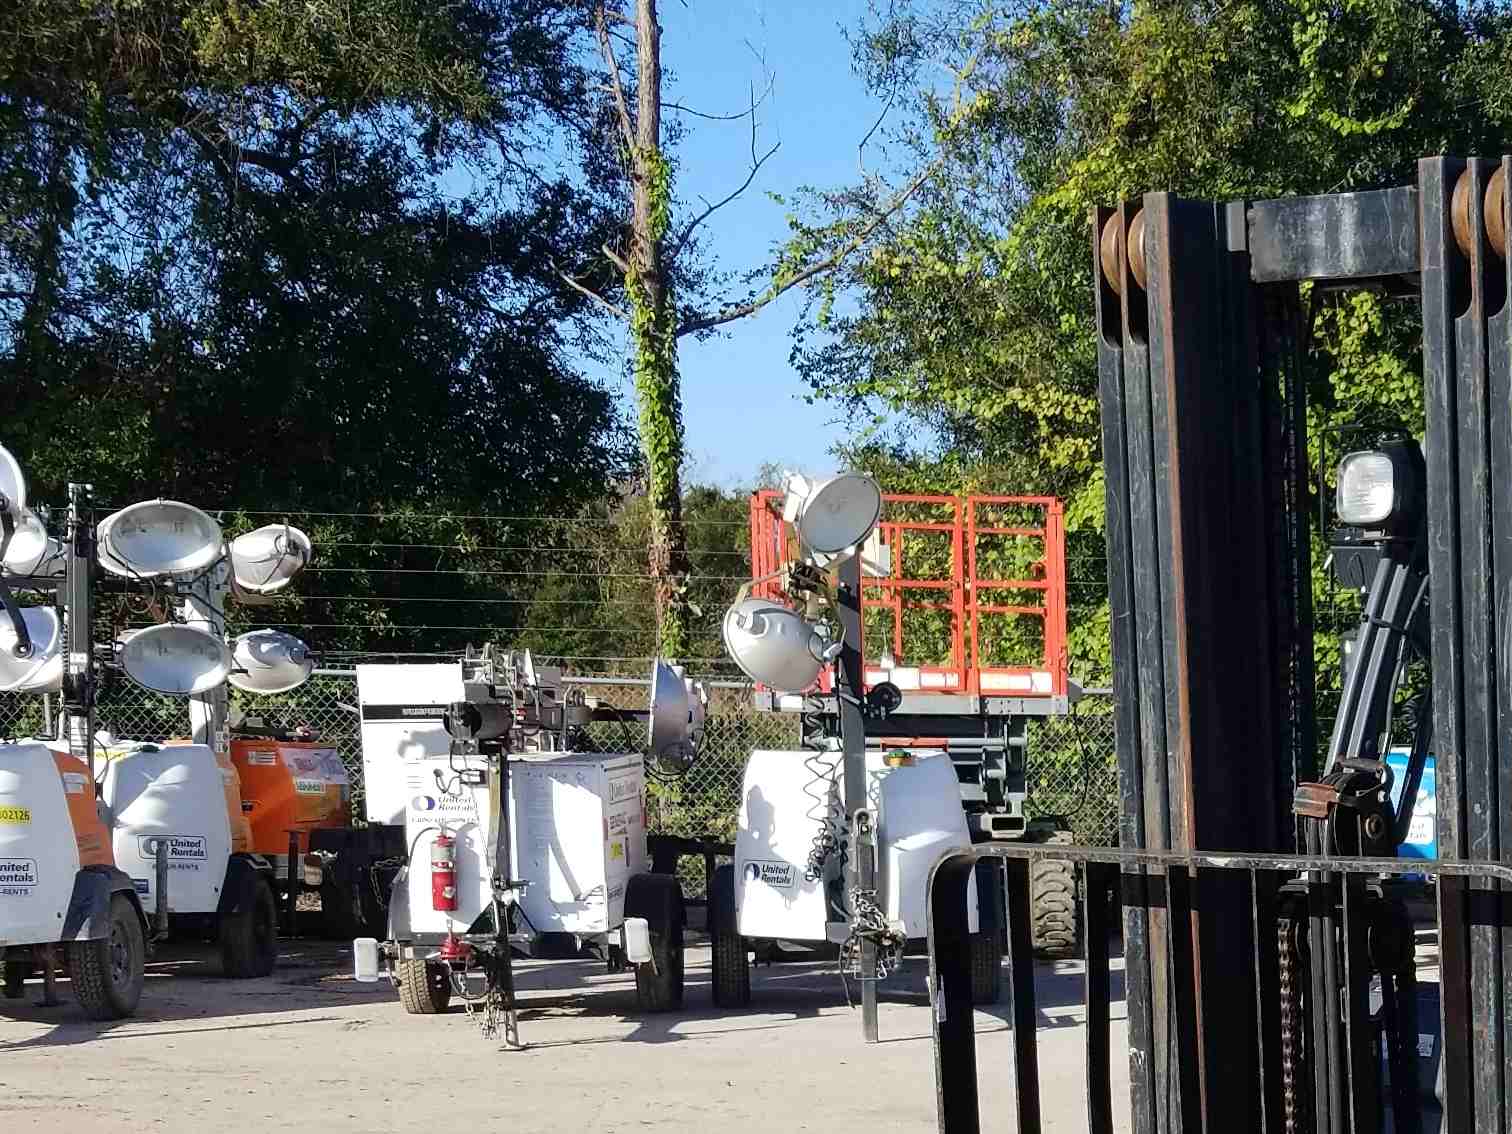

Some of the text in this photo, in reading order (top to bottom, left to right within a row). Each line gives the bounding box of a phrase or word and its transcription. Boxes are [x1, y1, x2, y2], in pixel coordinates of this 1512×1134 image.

[169, 839, 201, 848] United
[170, 847, 205, 857] Rentals
[0, 862, 29, 872] nited
[762, 863, 790, 875] United
[0, 872, 34, 882] entals
[761, 873, 792, 884] Rentals
